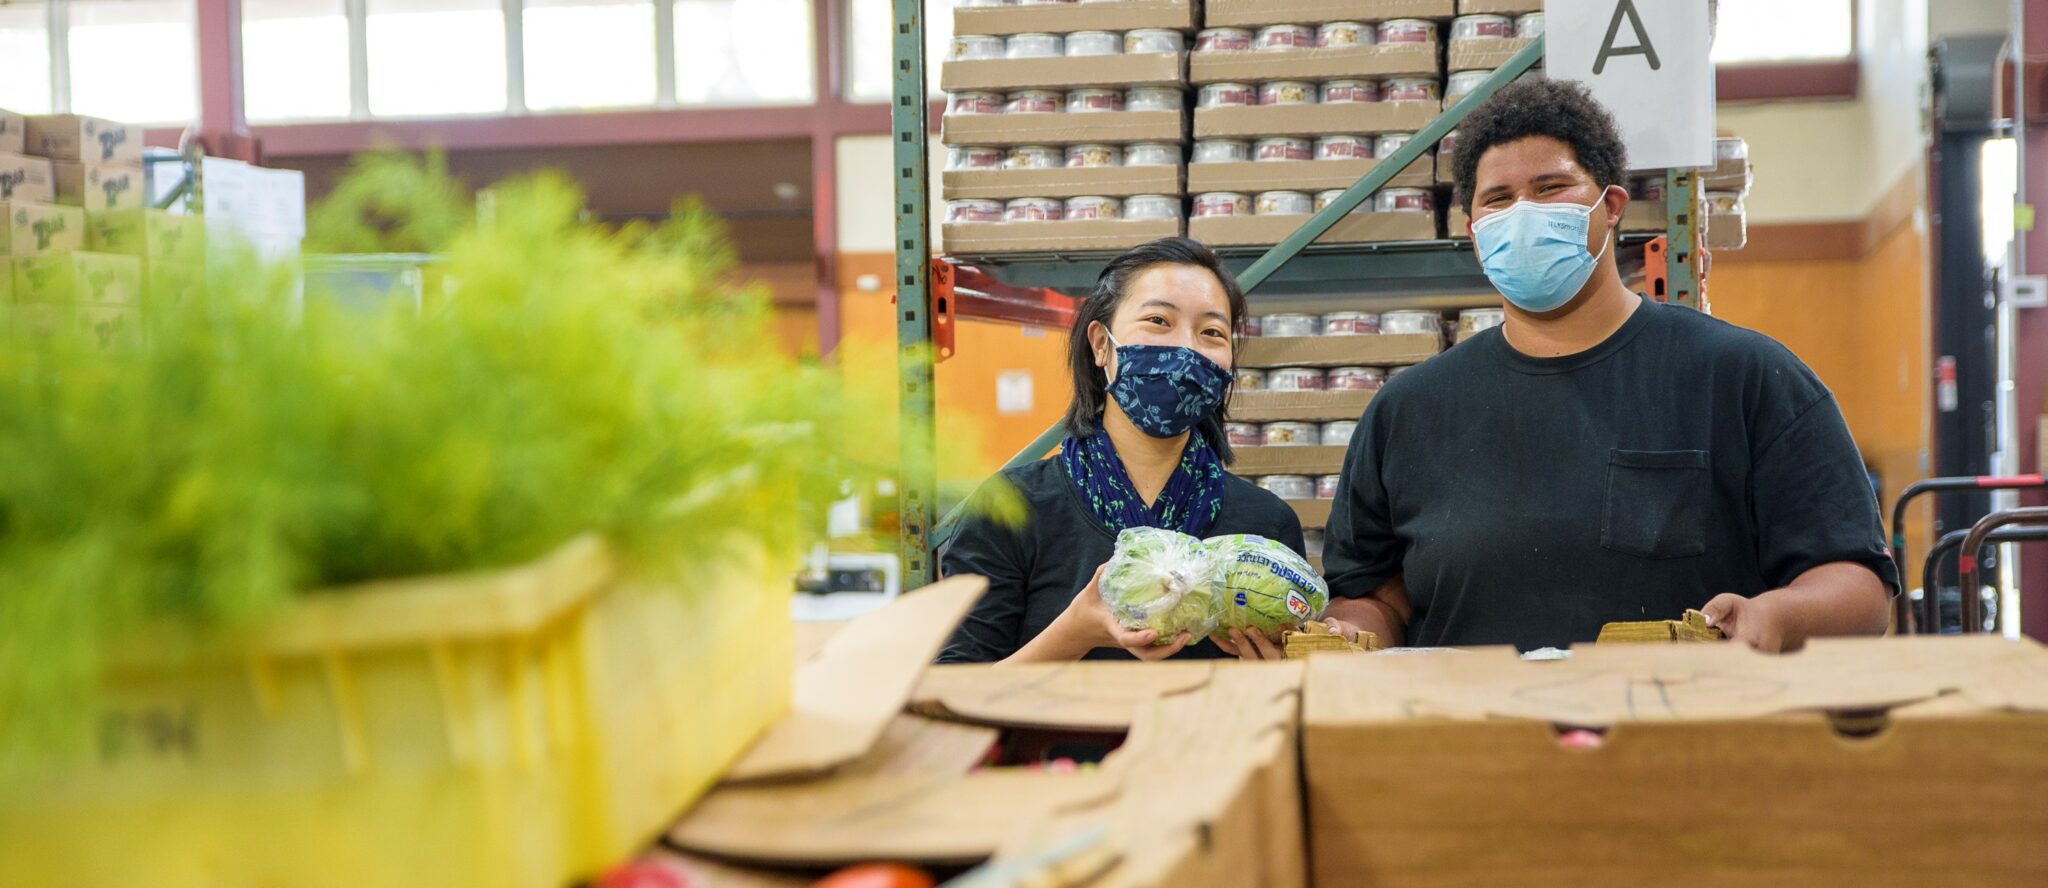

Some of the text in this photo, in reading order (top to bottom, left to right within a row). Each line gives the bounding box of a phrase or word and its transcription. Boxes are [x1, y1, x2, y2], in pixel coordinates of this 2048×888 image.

[1592, 0, 1661, 75] A
[1236, 555, 1270, 566] LETTUCE
[1270, 562, 1317, 594] ICEBERG
